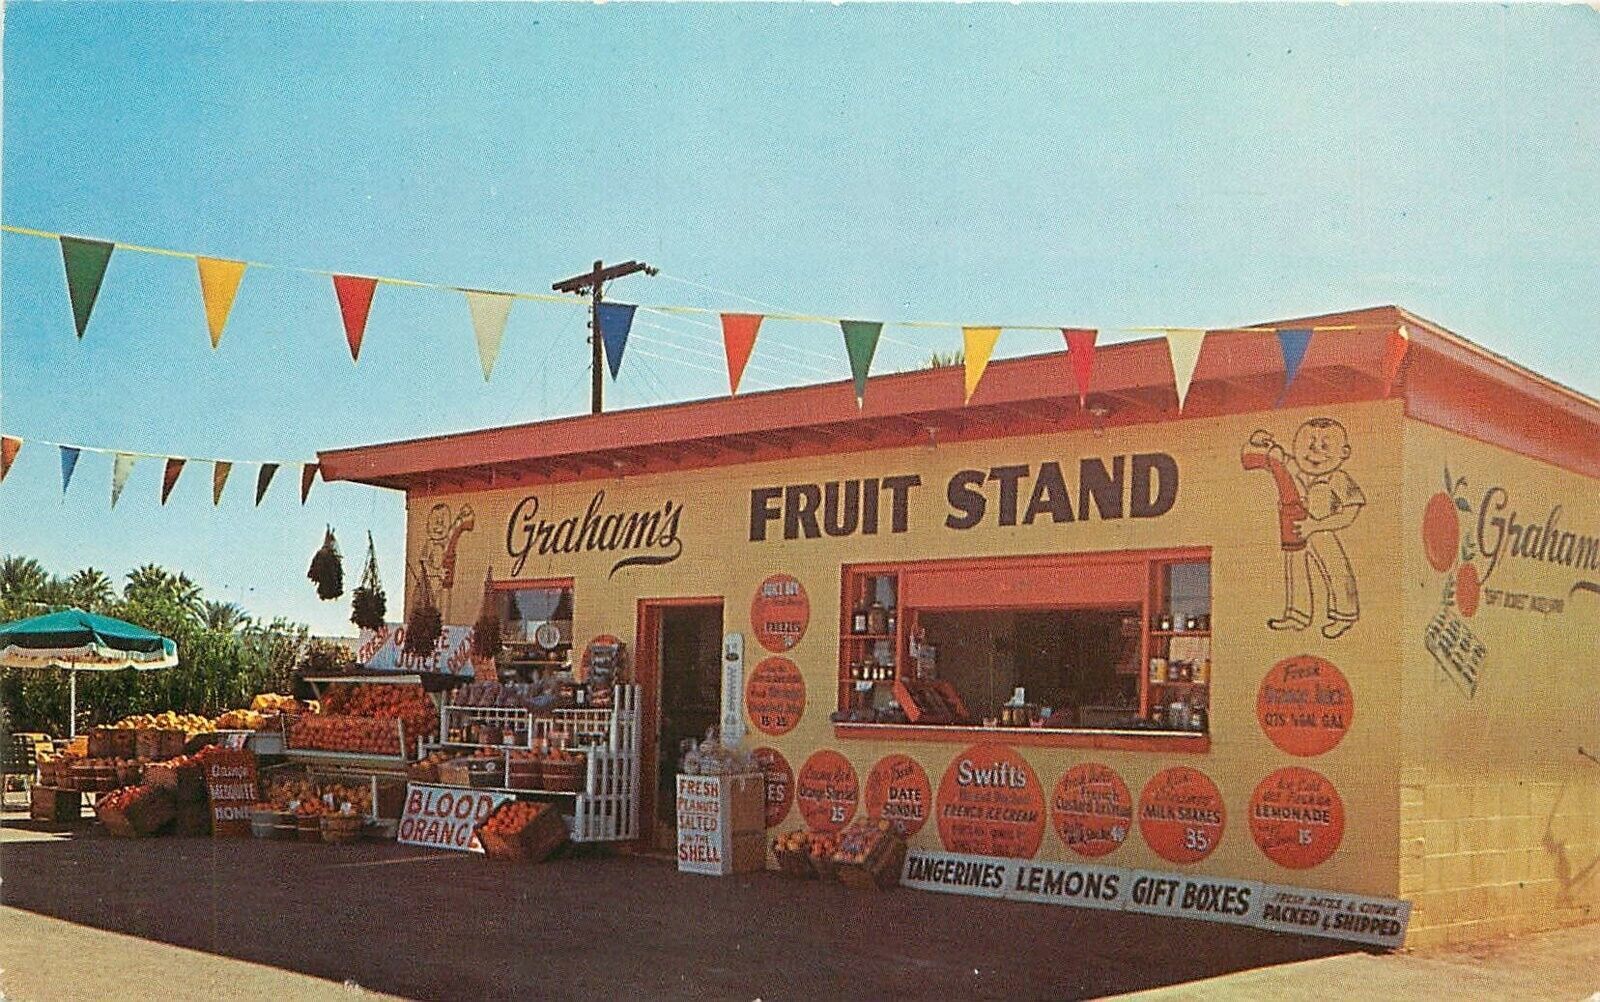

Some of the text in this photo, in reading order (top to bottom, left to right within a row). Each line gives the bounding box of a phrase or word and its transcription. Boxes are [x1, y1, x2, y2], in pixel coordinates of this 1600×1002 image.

[749, 452, 1180, 542] FRUIT STAND
[507, 489, 683, 578] Graham's
[679, 778, 719, 798] FRESH
[888, 786, 922, 802] DATE
[407, 789, 494, 825] BLOOD
[678, 797, 720, 813] PEANUTS
[1003, 807, 1039, 823] CREAM
[1142, 803, 1175, 820] MILK
[1255, 804, 1331, 824] LEMONADE
[679, 814, 717, 832] SALTED
[679, 843, 721, 864] SHELL
[907, 856, 1252, 915] TANGERINES LEMONS GIFT BOXES
[1262, 902, 1320, 927] PACKED
[1333, 913, 1402, 937] SHIPPED
